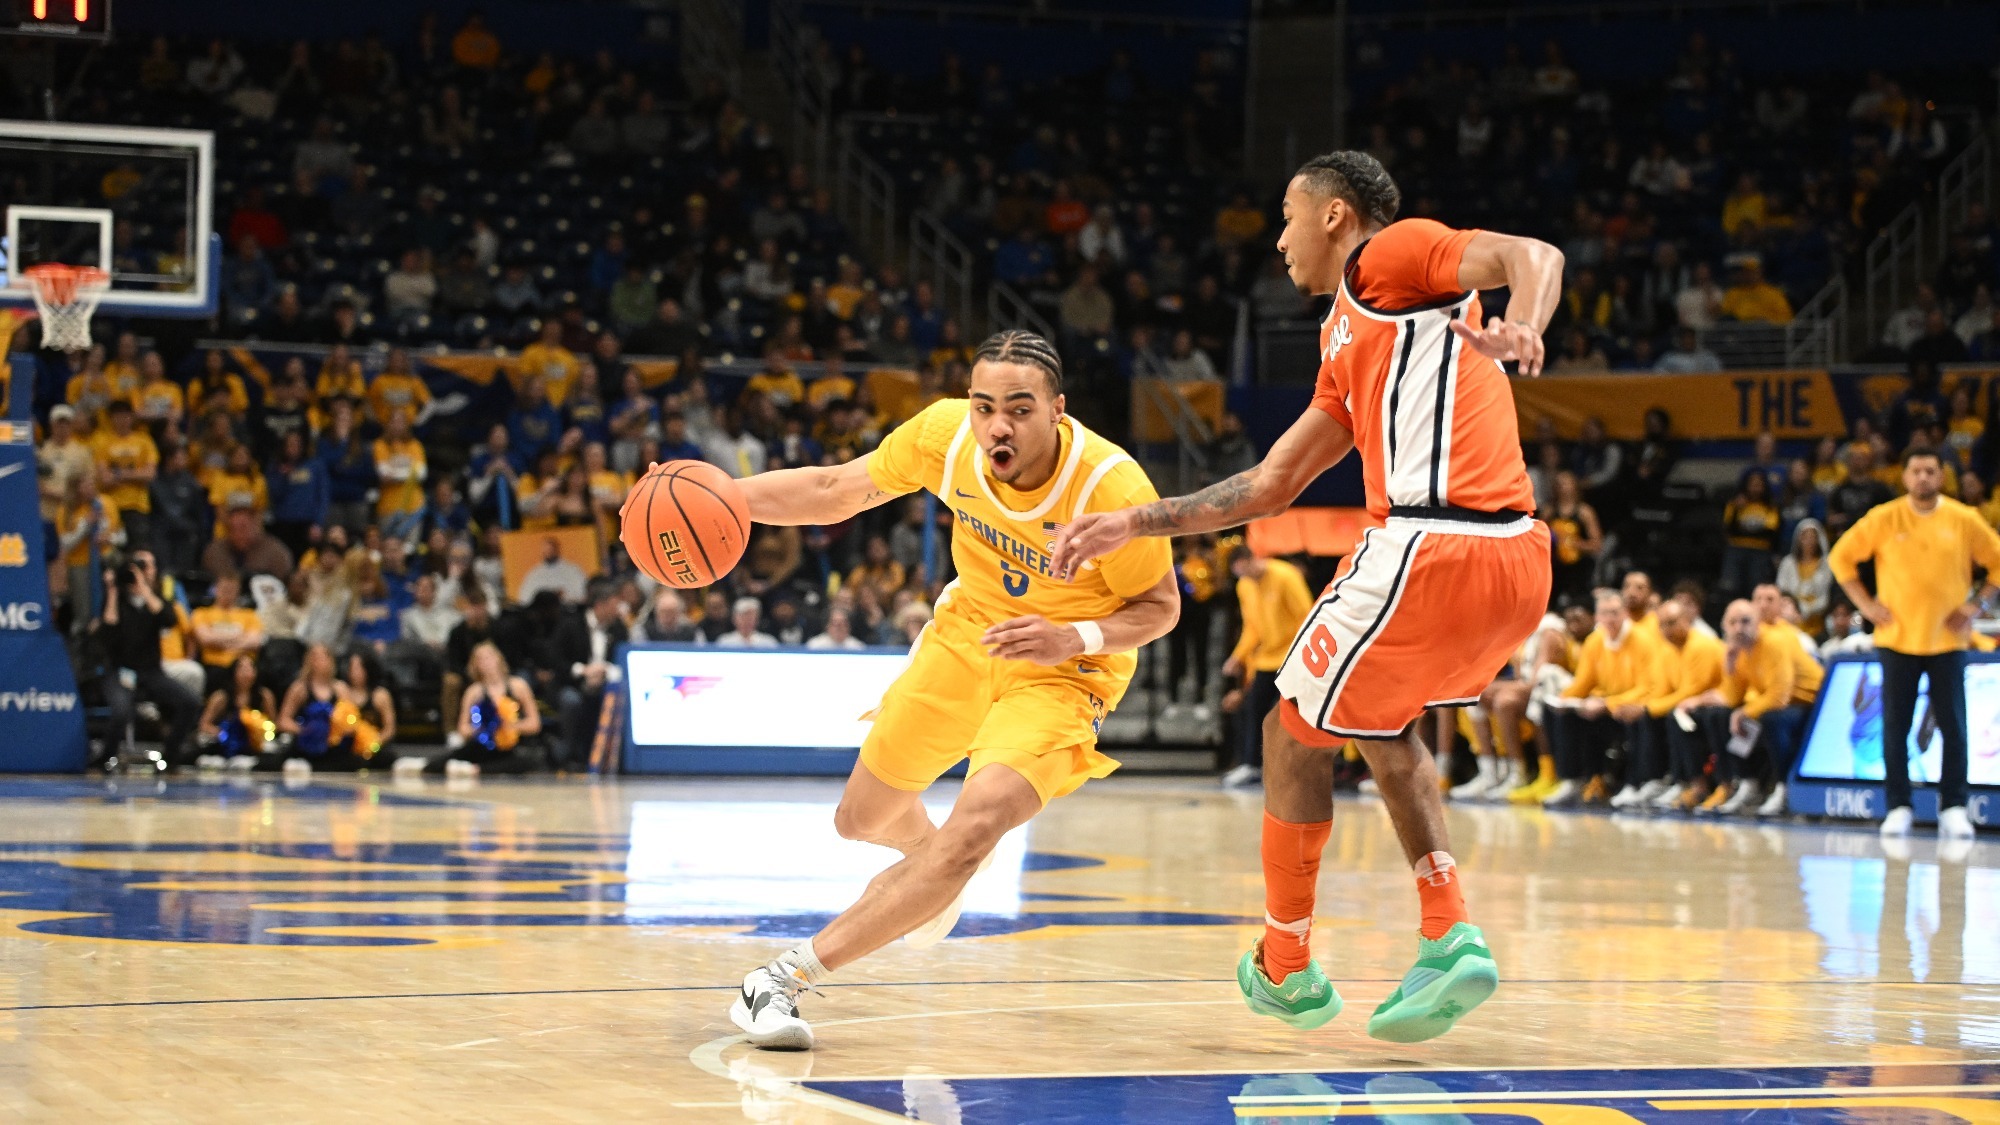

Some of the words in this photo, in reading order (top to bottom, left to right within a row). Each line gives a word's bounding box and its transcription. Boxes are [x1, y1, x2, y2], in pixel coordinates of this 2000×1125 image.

[1733, 378, 1812, 430] THE
[658, 530, 699, 585] ELITE
[1000, 559, 1030, 597] 5
[1302, 624, 1337, 678] S
[1825, 787, 1875, 819] UPMC
